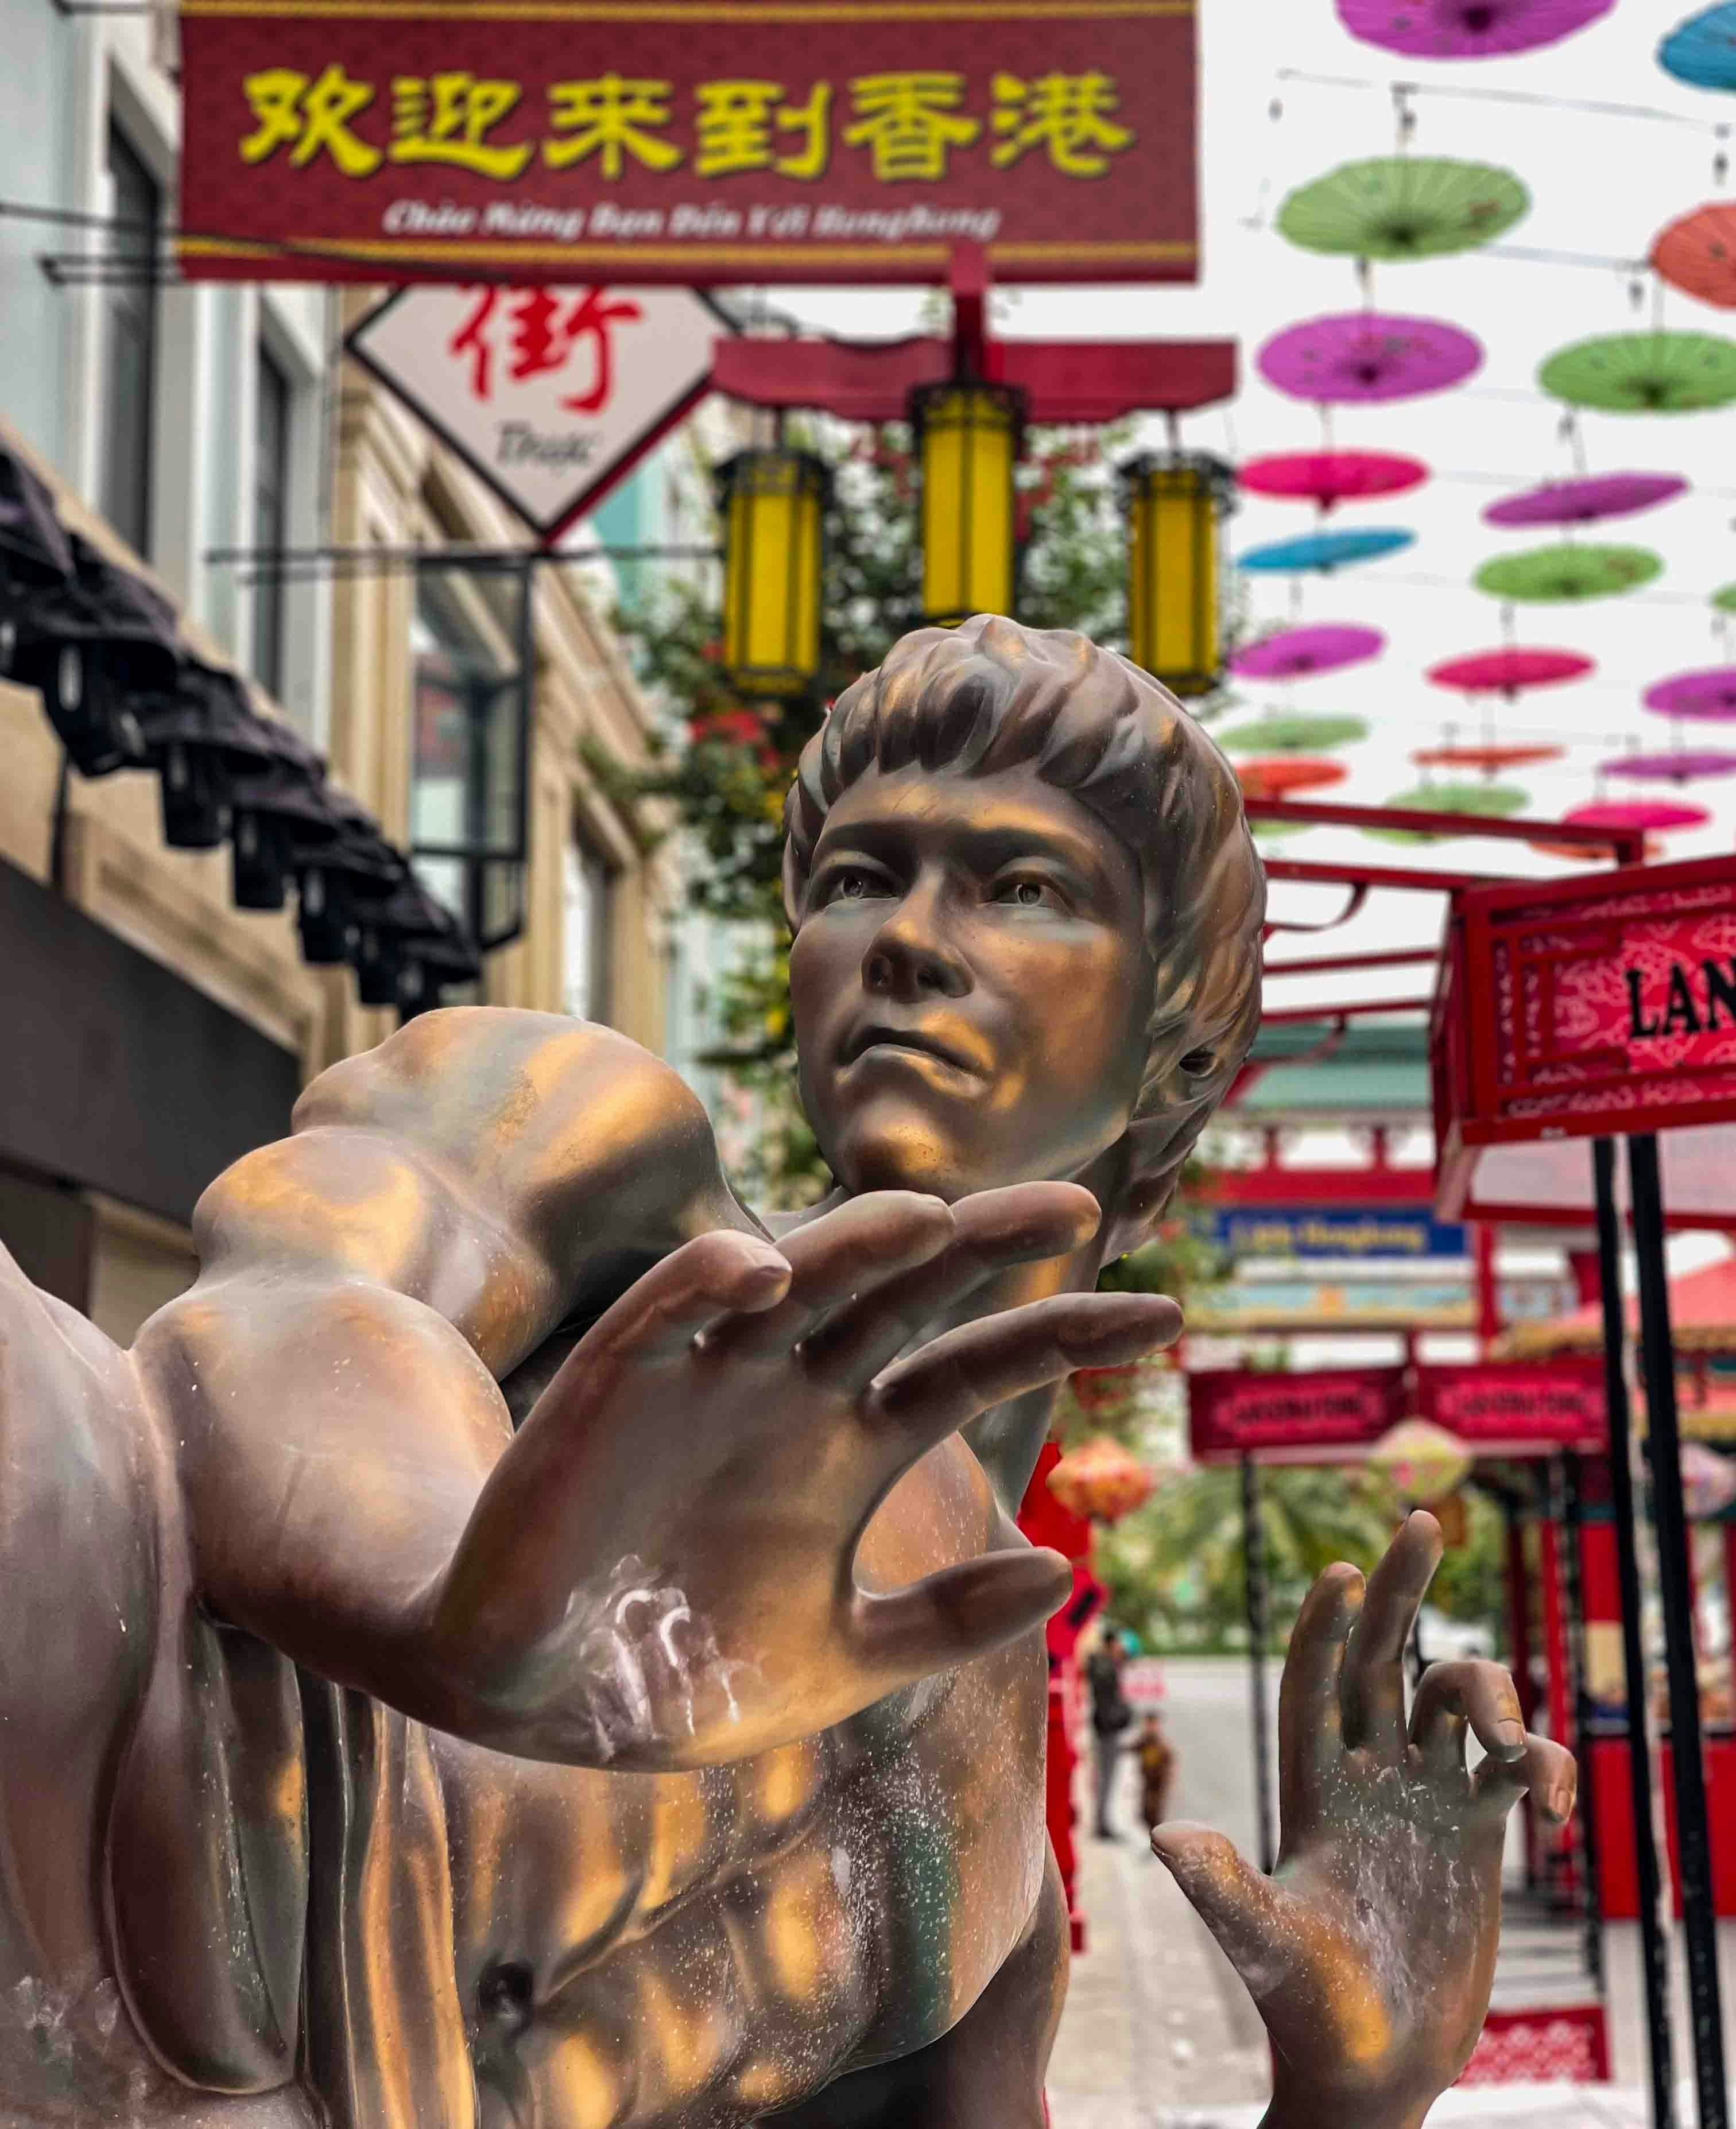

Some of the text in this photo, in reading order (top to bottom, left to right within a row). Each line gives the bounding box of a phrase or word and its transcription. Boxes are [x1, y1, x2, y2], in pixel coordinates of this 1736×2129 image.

[239, 65, 1134, 180] 欢迎来到香港
[1625, 959, 1736, 1038] LAN
